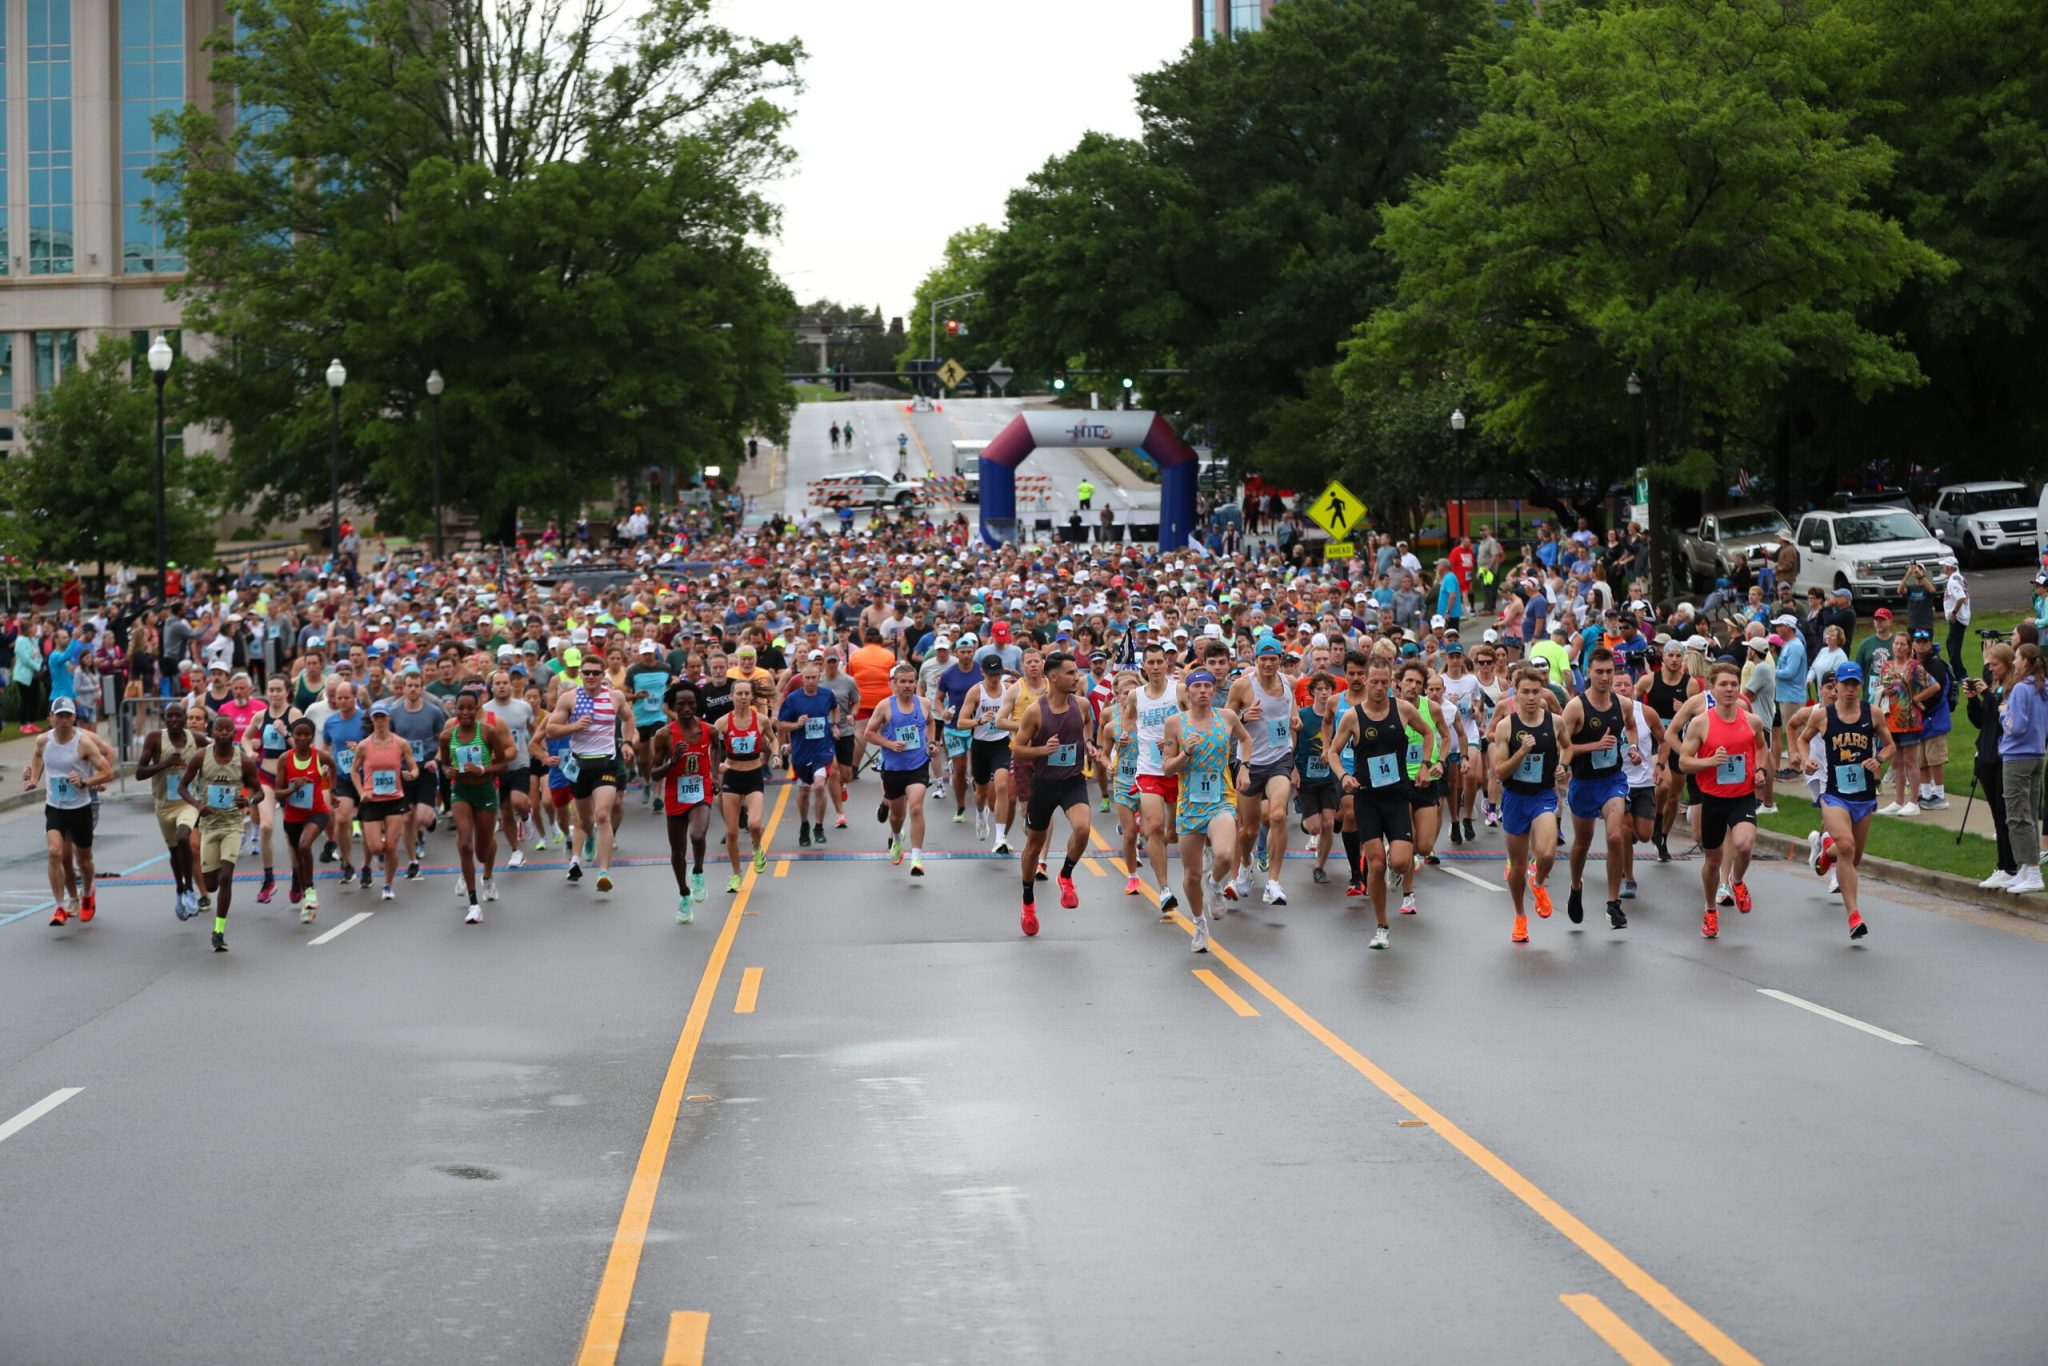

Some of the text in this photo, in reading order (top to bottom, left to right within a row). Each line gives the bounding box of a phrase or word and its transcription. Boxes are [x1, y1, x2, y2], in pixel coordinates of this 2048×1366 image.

[1328, 546, 1352, 555] AHEAD
[1139, 707, 1167, 719] FLEET
[1143, 717, 1165, 727] FEET
[1276, 727, 1286, 737] 15
[901, 733, 915, 742] 190
[1832, 732, 1868, 751] MARS
[739, 743, 748, 751] 21
[1060, 753, 1066, 761] 8
[1409, 751, 1417, 760] 17
[1379, 763, 1390, 774] 14
[1525, 762, 1531, 772] 3
[1728, 762, 1734, 773] 5
[1846, 773, 1857, 783] 12
[58, 784, 67, 793] 10
[681, 784, 700, 794] 1766
[1201, 781, 1210, 791] 11
[218, 794, 224, 803] 2
